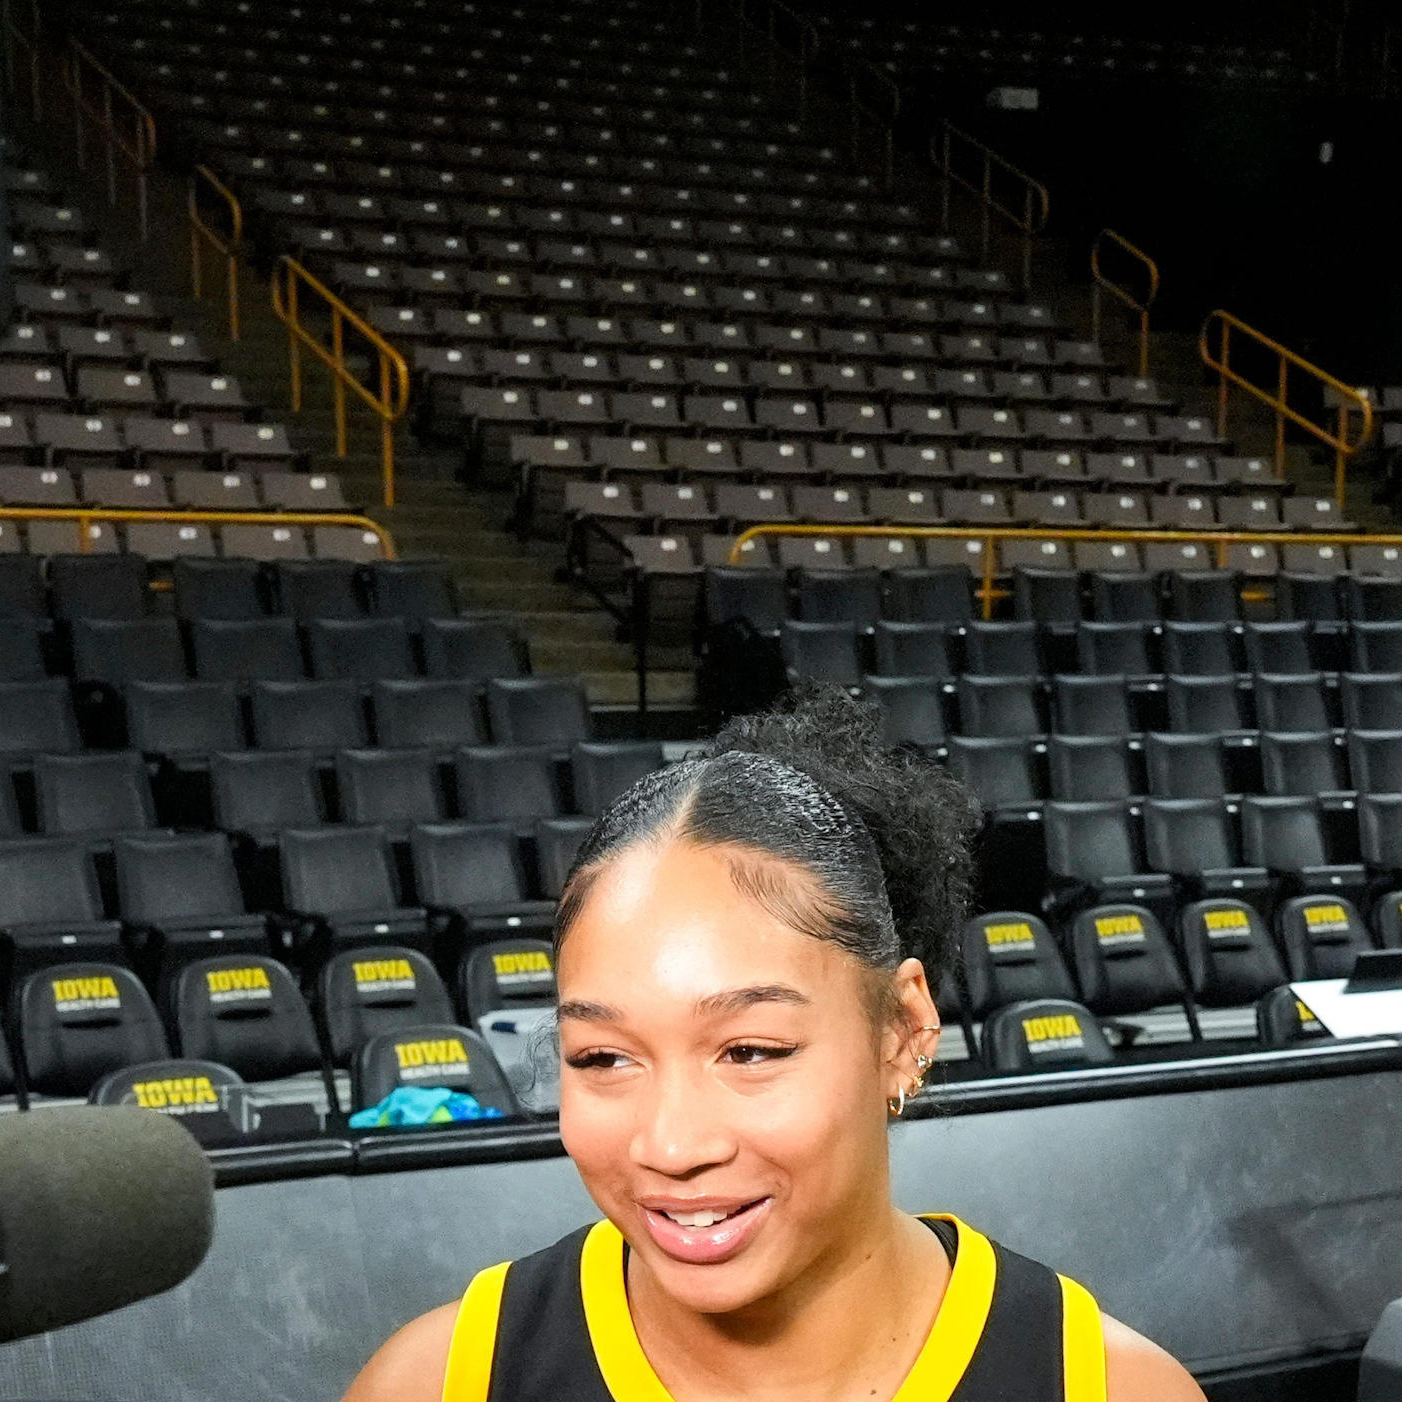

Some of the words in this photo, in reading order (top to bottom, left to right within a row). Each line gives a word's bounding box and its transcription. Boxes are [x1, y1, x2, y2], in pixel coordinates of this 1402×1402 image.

[207, 967, 271, 993] IOWA
[353, 959, 415, 983] IOWA
[53, 976, 119, 1002] IOWA
[396, 1038, 469, 1068] IOWA
[133, 1076, 219, 1109] IOWA
